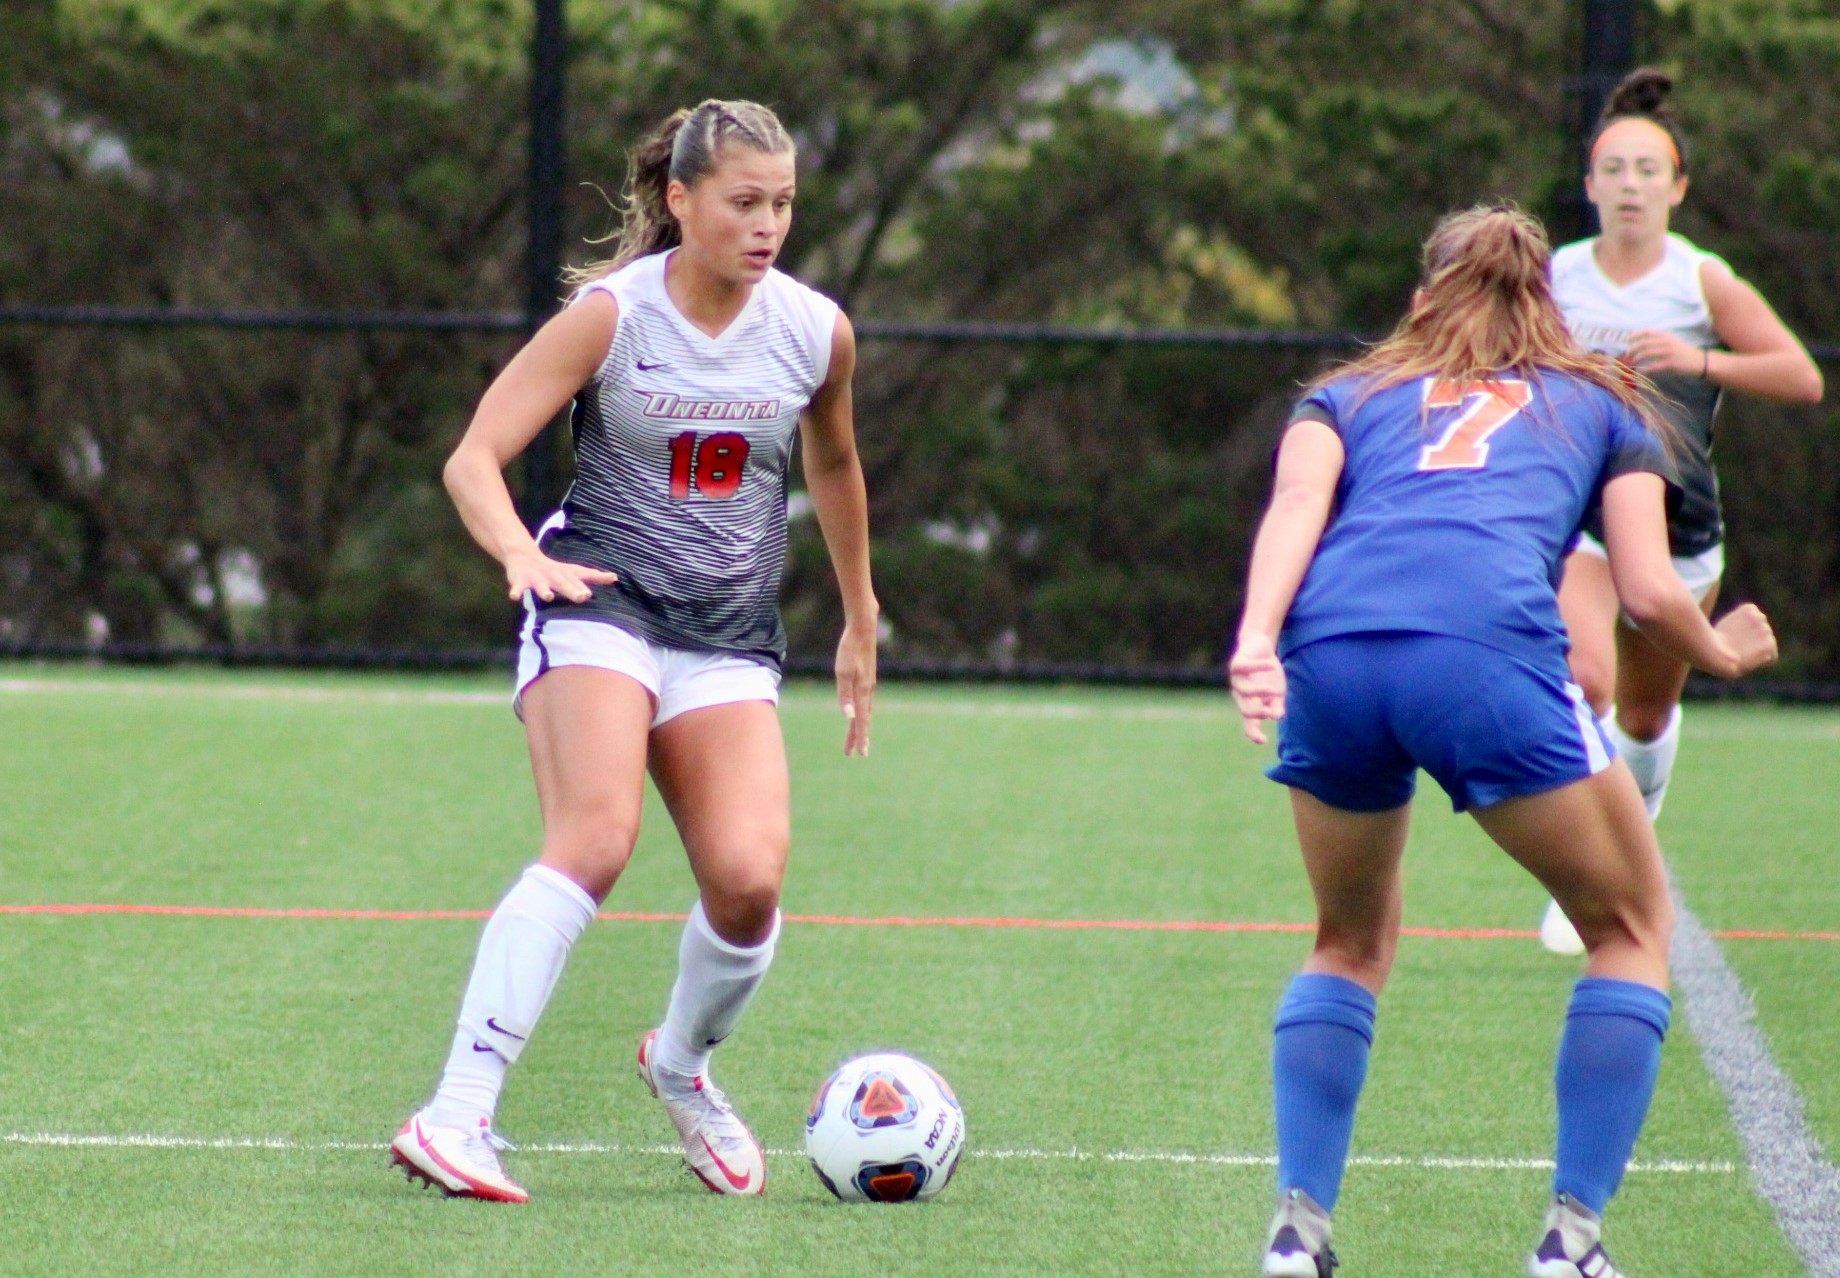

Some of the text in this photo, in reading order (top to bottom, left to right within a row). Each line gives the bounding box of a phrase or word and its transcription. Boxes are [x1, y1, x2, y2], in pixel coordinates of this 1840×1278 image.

[635, 390, 780, 420] ONEONTA
[1418, 377, 1533, 470] 7
[668, 431, 750, 500] 18
[925, 1108, 948, 1149] NCAA
